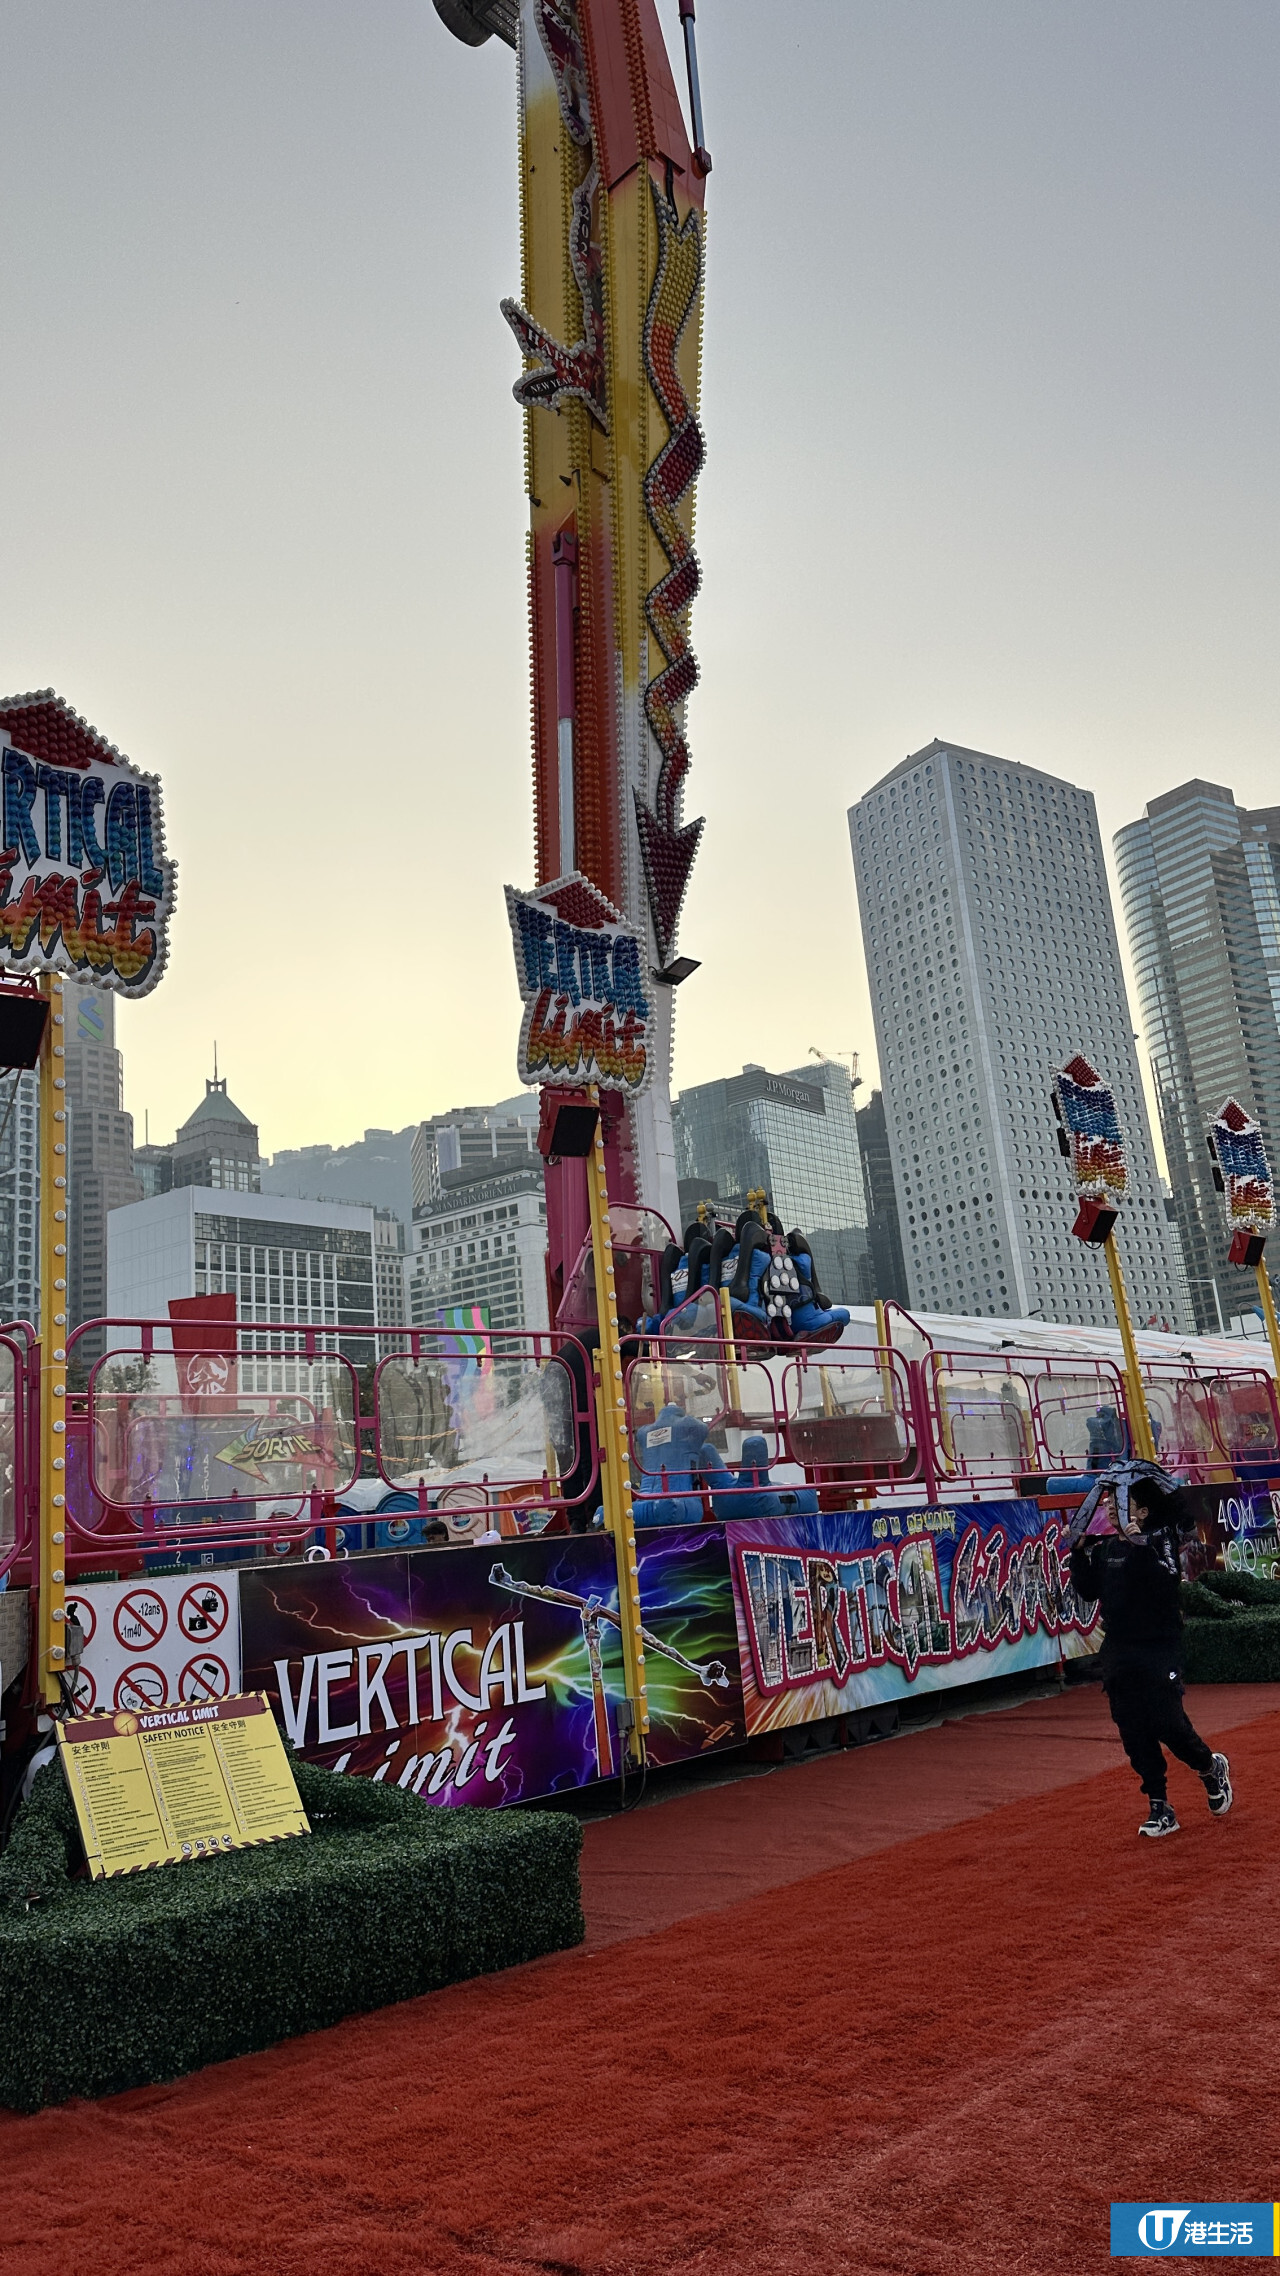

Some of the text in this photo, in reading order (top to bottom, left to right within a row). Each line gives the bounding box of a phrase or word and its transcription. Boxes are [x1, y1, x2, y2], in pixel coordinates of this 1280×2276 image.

[527, 328, 585, 380] HAPPY
[530, 375, 573, 394] NEW YEAR
[434, 1183, 517, 1213] MANDARIN ORIENTAL
[231, 1434, 321, 1462] SORTIE
[138, 1602, 161, 1617] -12ans
[740, 1538, 952, 1688] VERTICAL
[121, 1623, 142, 1639] -1m40
[274, 1620, 547, 1750] VERTICAL
[140, 1705, 219, 1728] VERTICAL LIMIT
[142, 1726, 205, 1744] SAFETY NOTICE
[332, 1716, 517, 1796] imit
